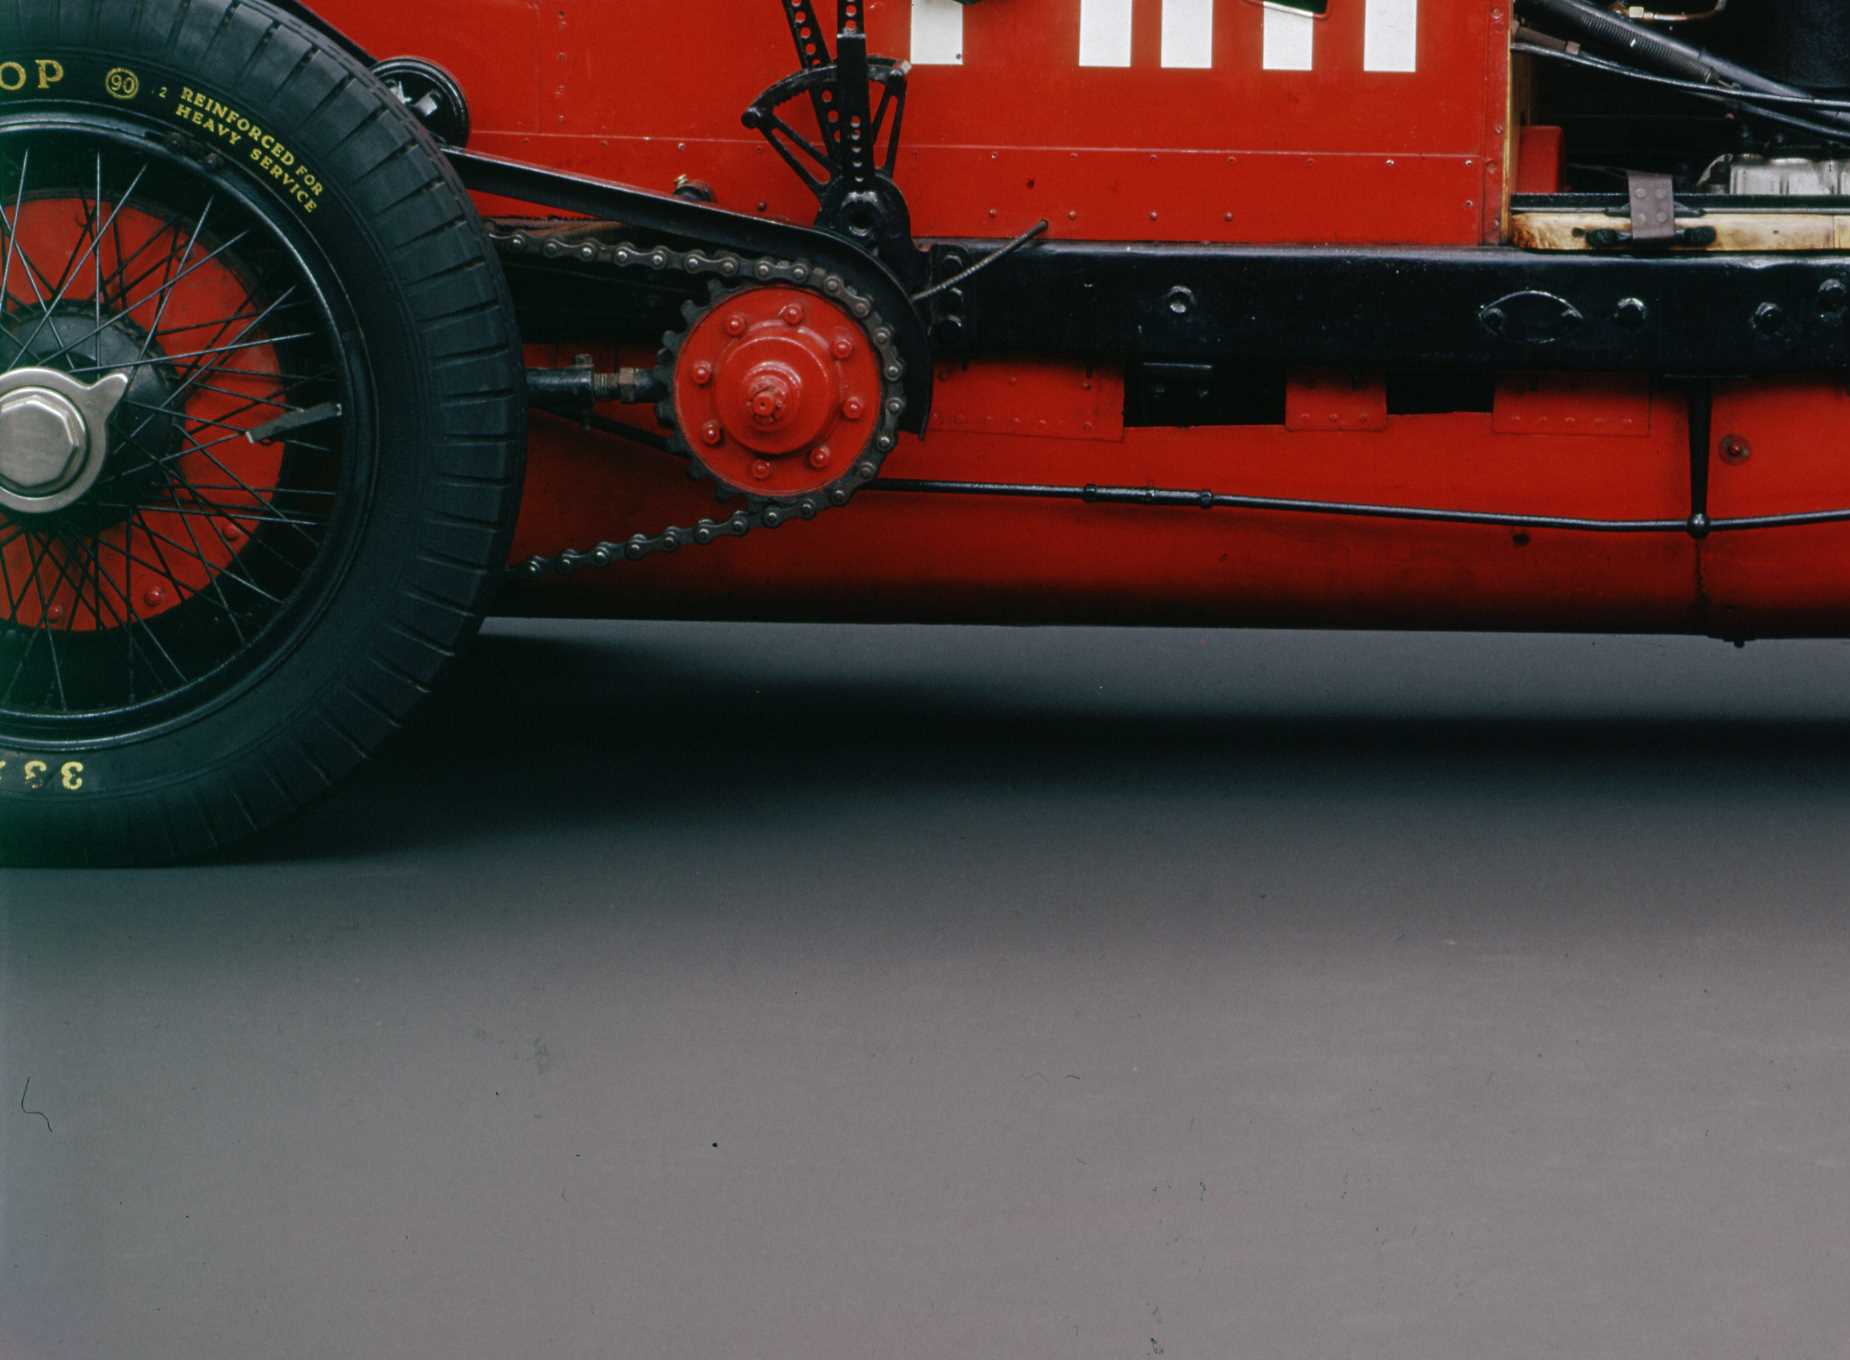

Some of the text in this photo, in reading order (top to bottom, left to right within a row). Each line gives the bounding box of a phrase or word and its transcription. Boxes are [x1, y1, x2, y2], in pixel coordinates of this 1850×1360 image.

[175, 104, 318, 213] HEAVY SERVICE
[181, 85, 324, 197] REINFORCED FOR
